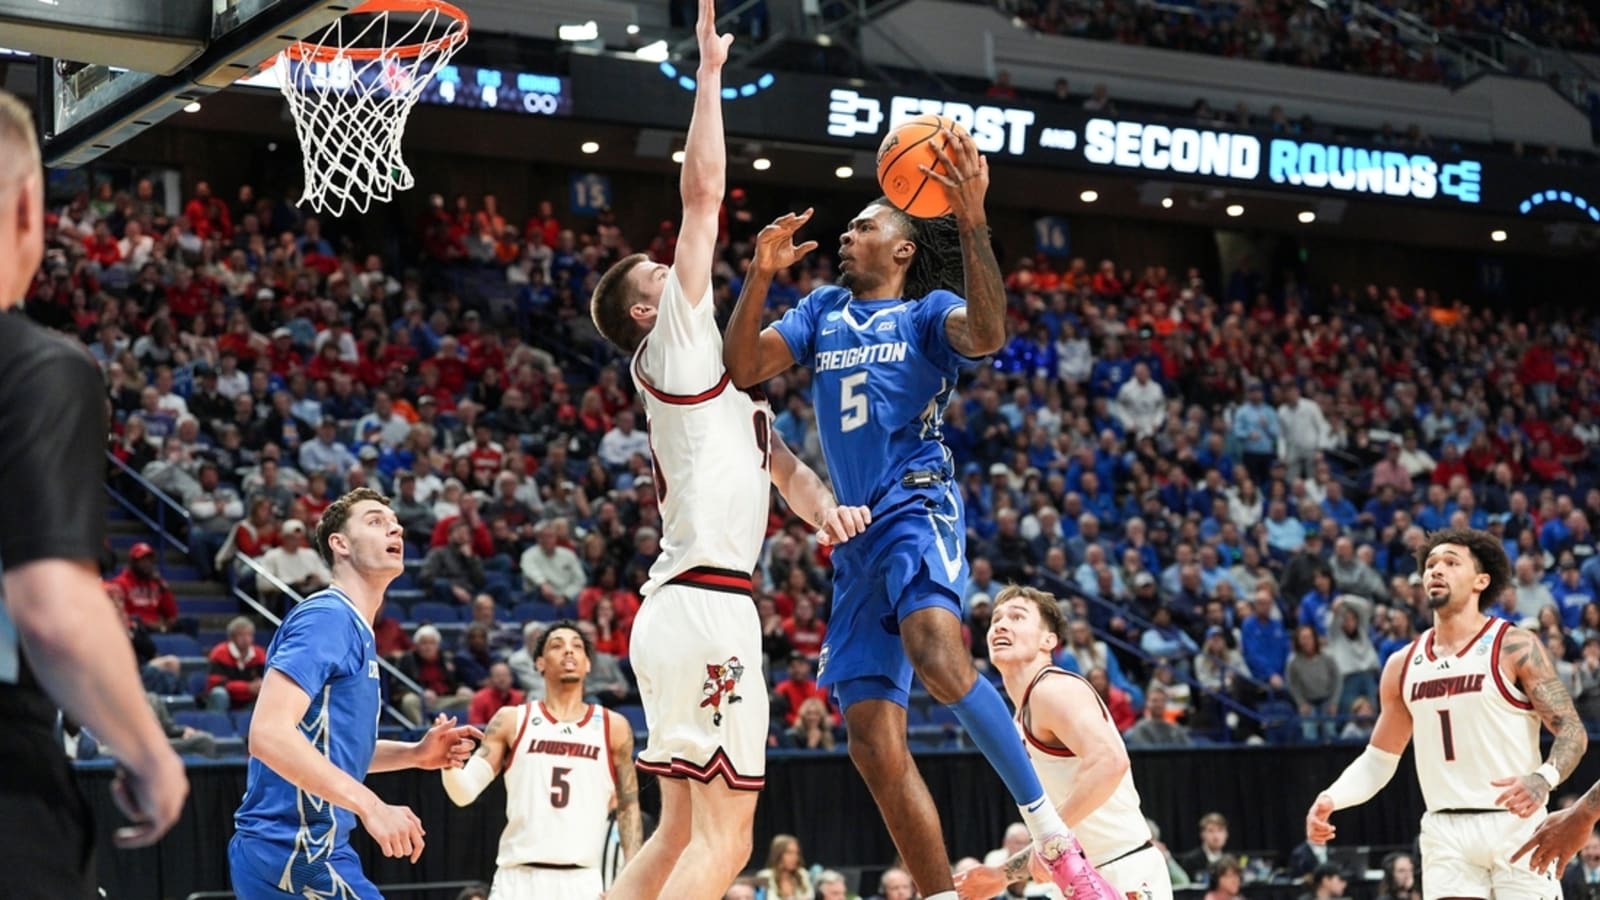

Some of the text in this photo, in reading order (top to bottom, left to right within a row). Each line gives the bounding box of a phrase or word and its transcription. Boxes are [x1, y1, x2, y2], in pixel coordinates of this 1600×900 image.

[1084, 118, 1260, 180] SECOND
[1270, 139, 1437, 199] ROUNDS
[575, 181, 605, 208] 15
[815, 342, 907, 373] CREIGHTON
[840, 371, 868, 433] 5
[1410, 674, 1486, 702] LOUISVILLE
[527, 738, 601, 761] LOUISVILLE
[1437, 709, 1455, 761] 1
[550, 766, 572, 809] 5
